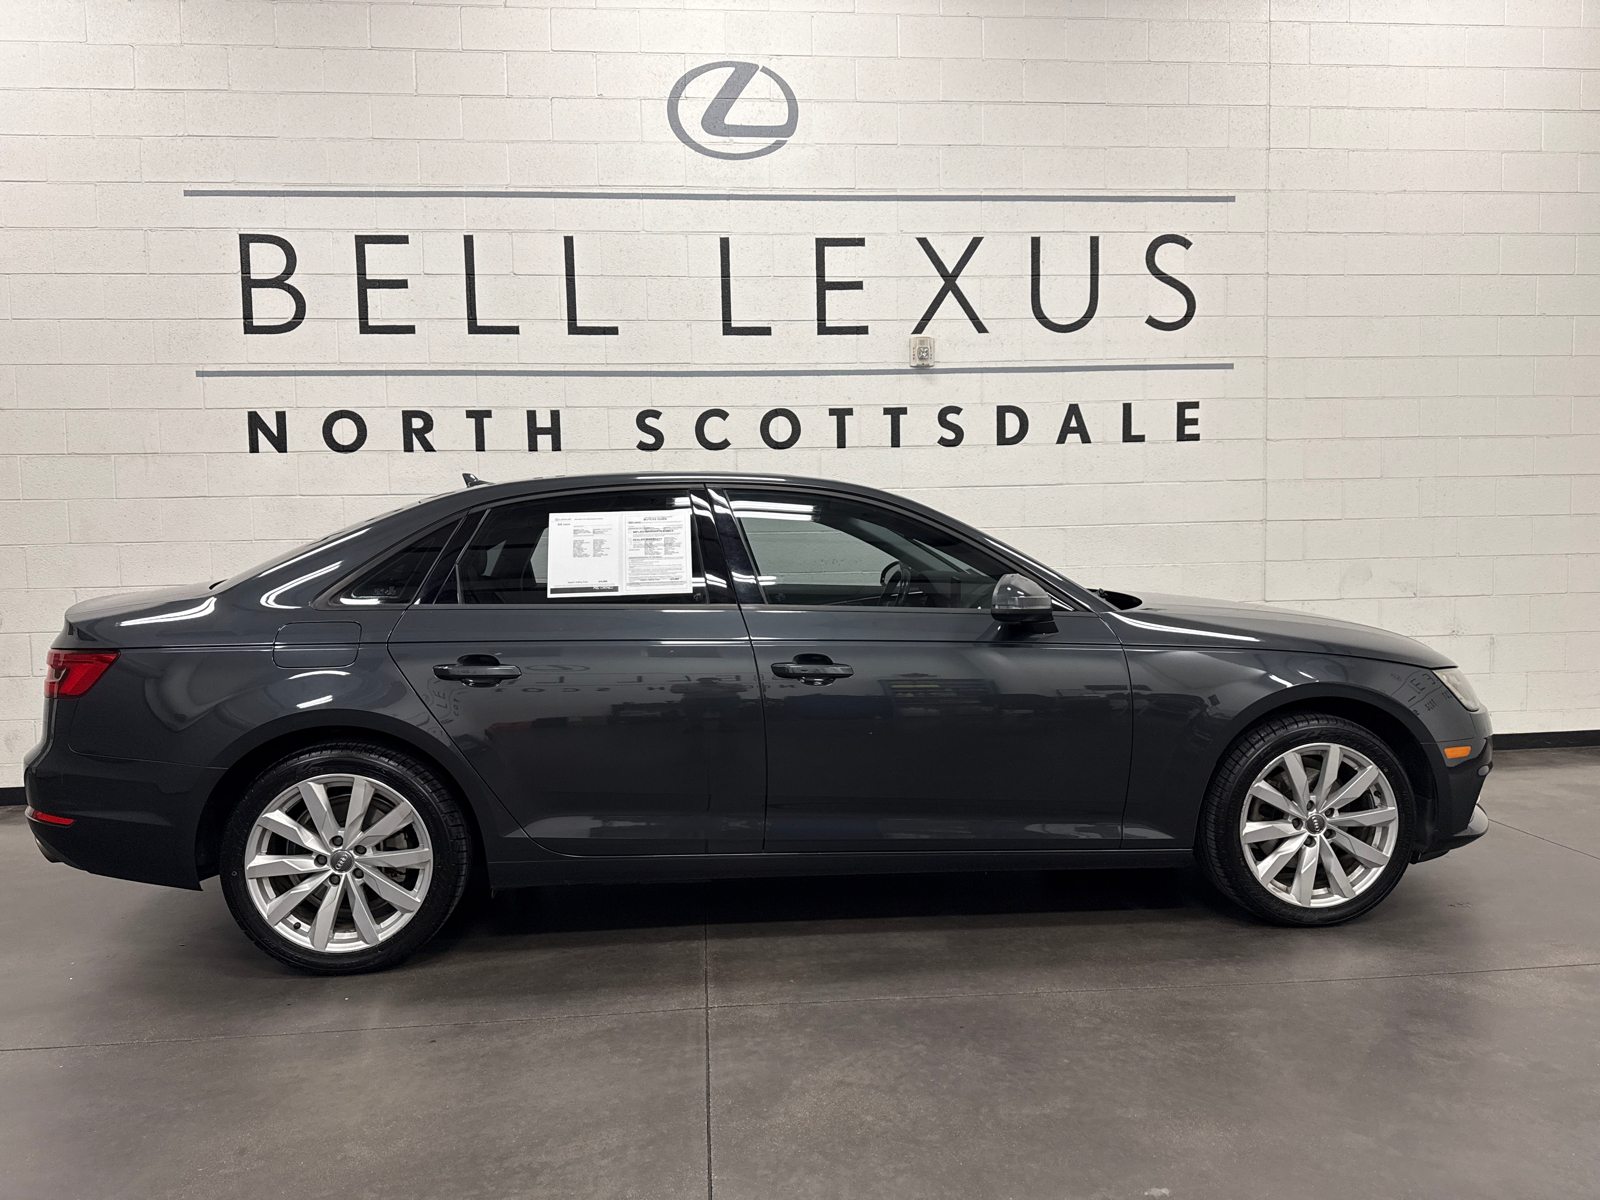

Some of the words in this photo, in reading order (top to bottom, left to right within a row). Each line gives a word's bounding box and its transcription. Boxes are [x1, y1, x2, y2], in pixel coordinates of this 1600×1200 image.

[238, 233, 619, 336] BELL
[719, 233, 1197, 336] LEXUS
[247, 409, 562, 454] NORTH
[635, 401, 1201, 452] SCOTTSDALE
